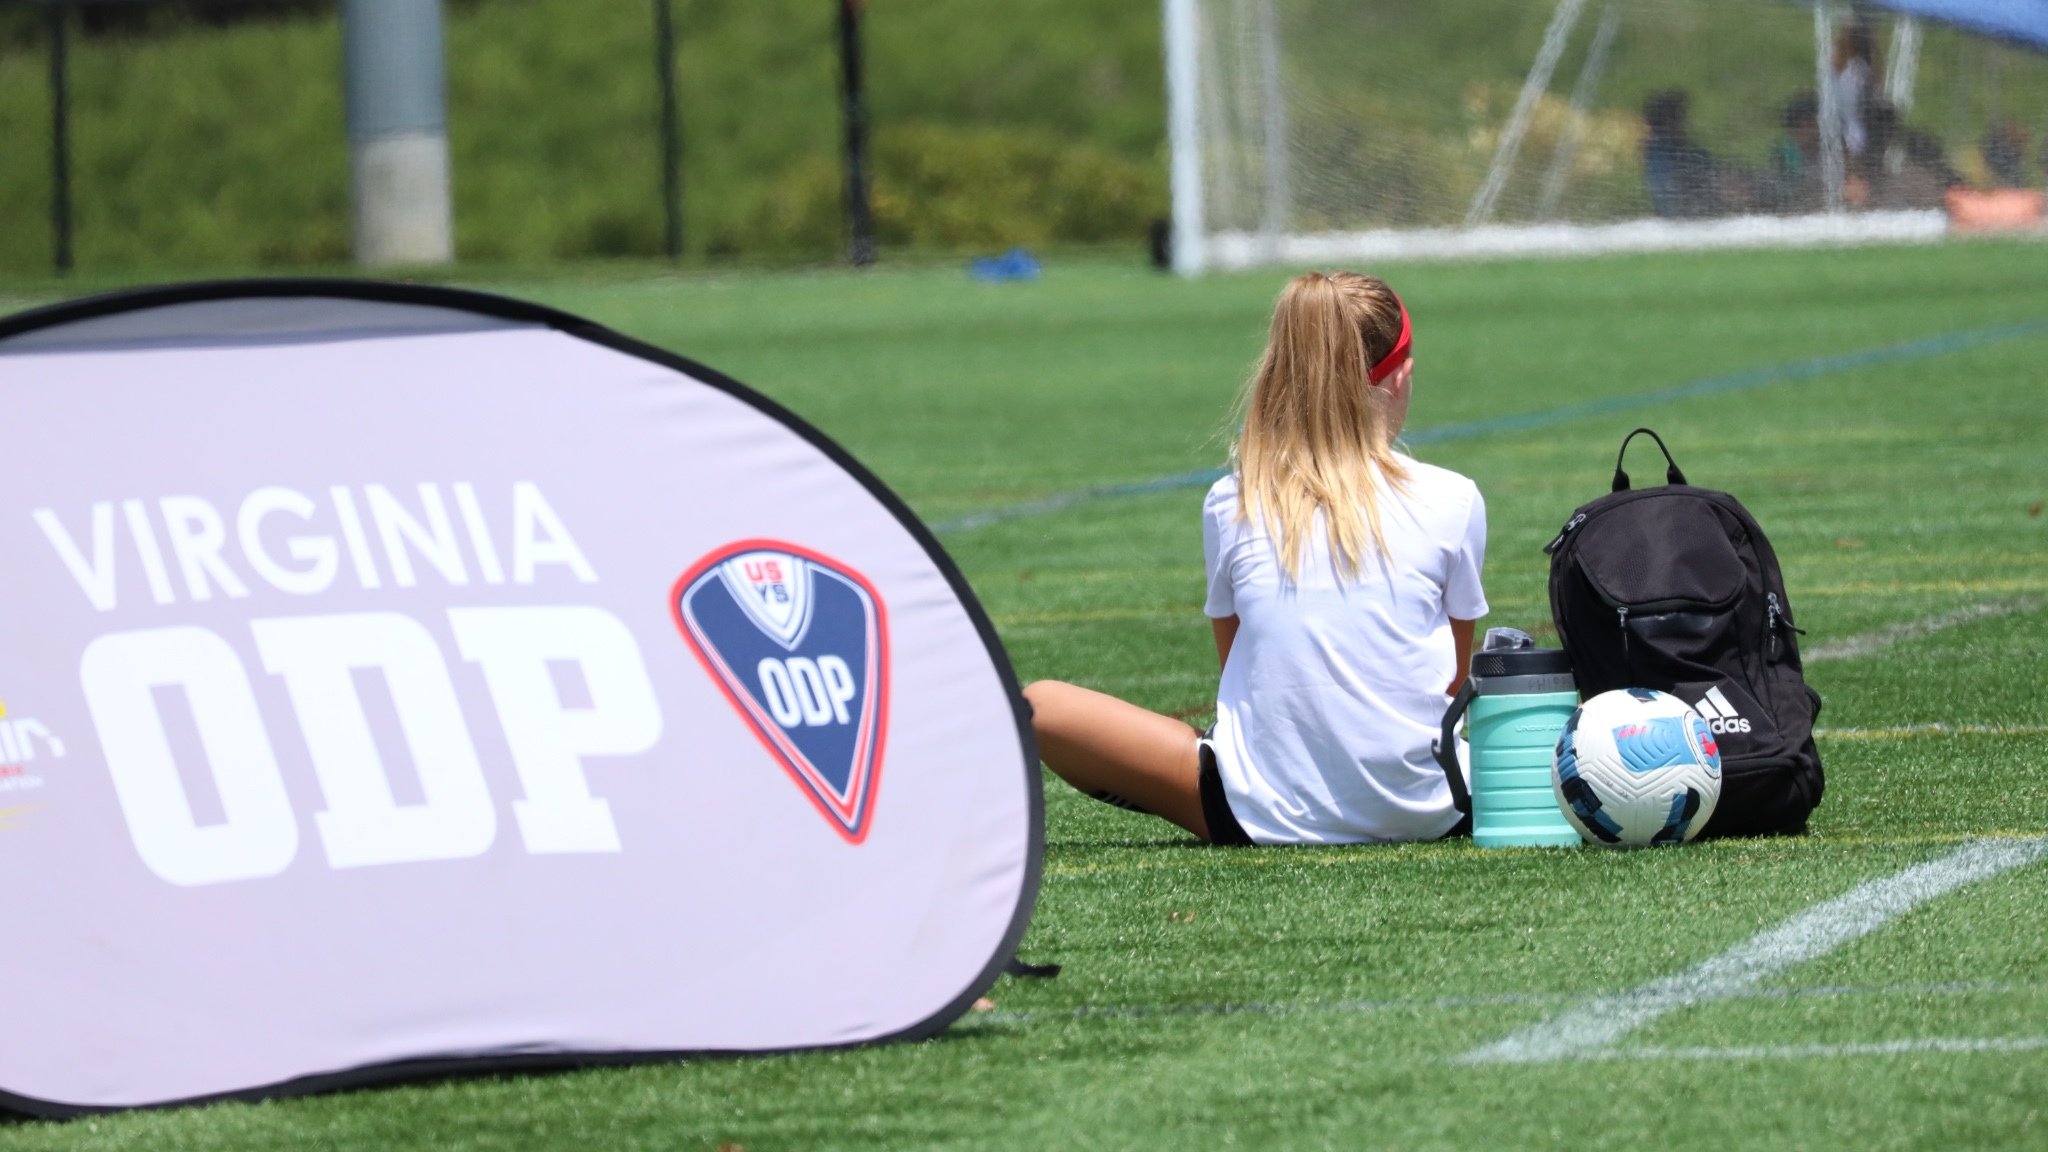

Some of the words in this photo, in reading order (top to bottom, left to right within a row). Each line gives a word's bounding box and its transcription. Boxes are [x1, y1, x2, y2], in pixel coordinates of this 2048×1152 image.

[32, 480, 600, 612] VIRGINIA
[744, 561, 783, 583] US
[753, 584, 790, 604] YS
[757, 654, 857, 729] ODP
[79, 605, 665, 888] ODP
